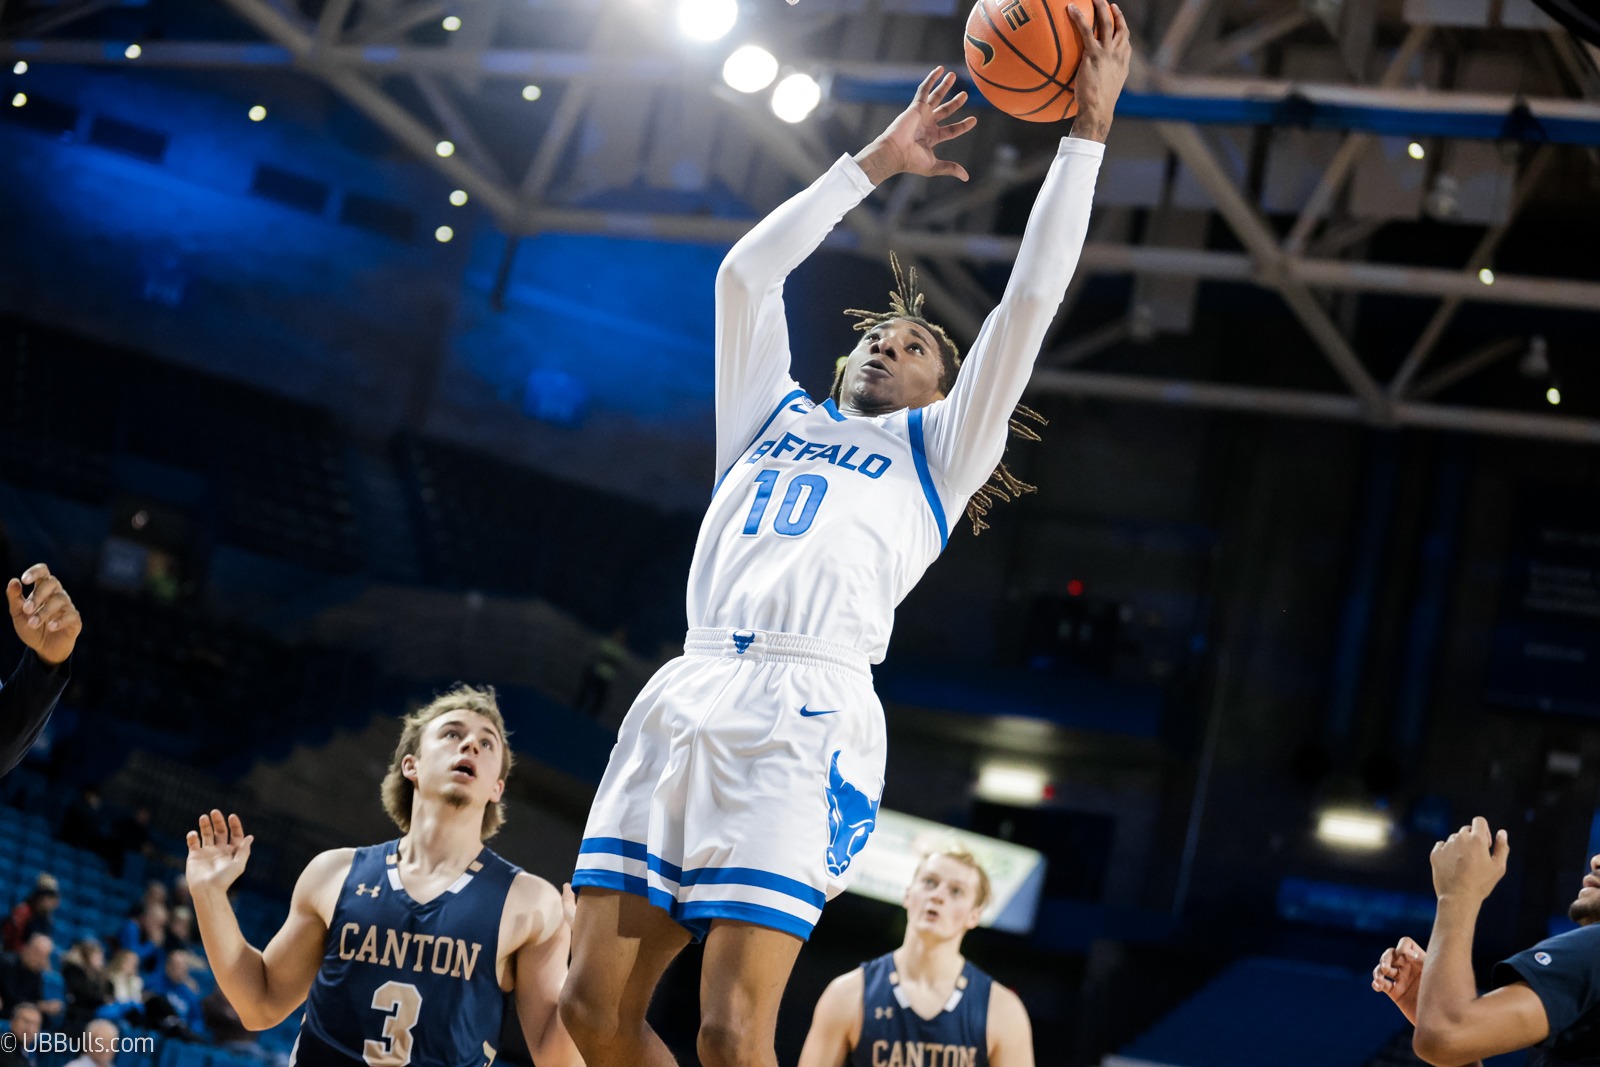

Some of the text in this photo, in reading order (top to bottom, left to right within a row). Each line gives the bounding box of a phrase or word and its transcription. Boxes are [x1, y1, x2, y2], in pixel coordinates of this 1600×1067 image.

[744, 432, 893, 479] BFFALO
[741, 469, 828, 537] 10
[339, 922, 482, 981] CANTON
[362, 980, 423, 1067] 3
[872, 1040, 978, 1067] CANTON
